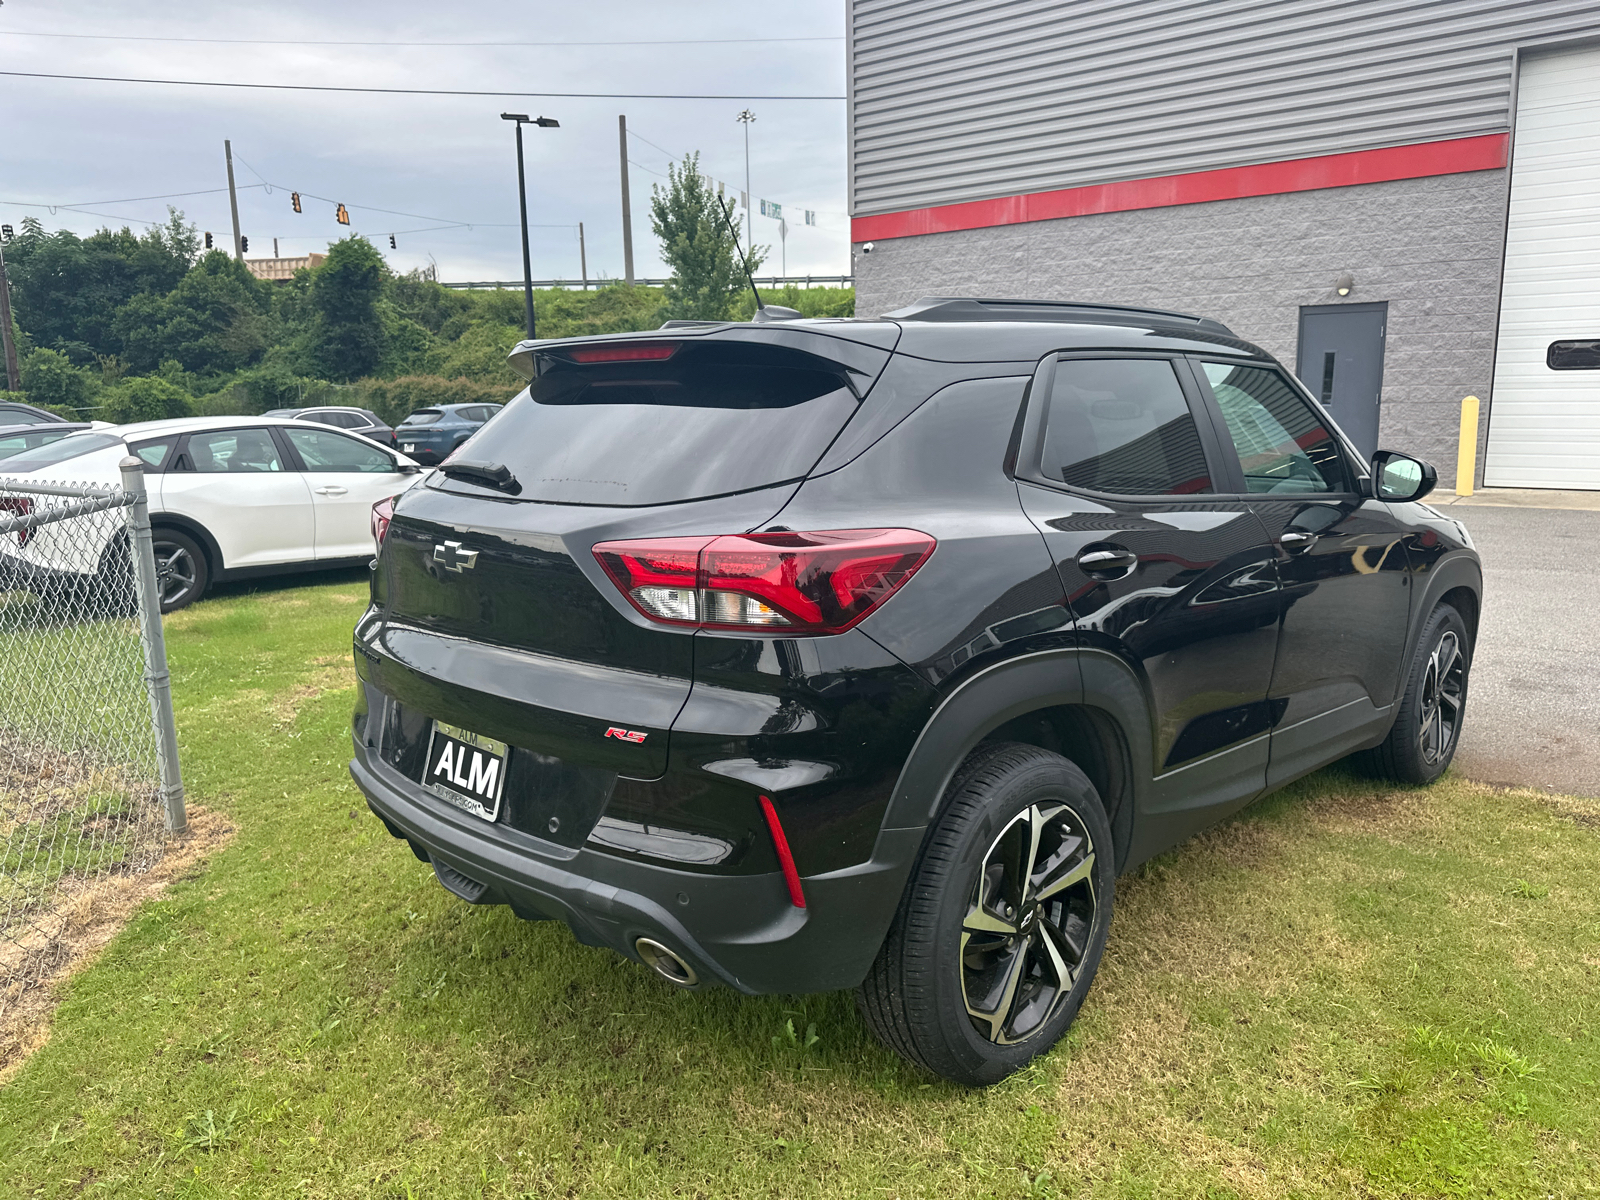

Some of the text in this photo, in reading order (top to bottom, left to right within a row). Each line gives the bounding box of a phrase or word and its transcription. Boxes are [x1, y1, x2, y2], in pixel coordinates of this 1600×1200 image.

[458, 729, 478, 746] ALM
[604, 727, 649, 744] RS
[434, 741, 499, 799] ALM
